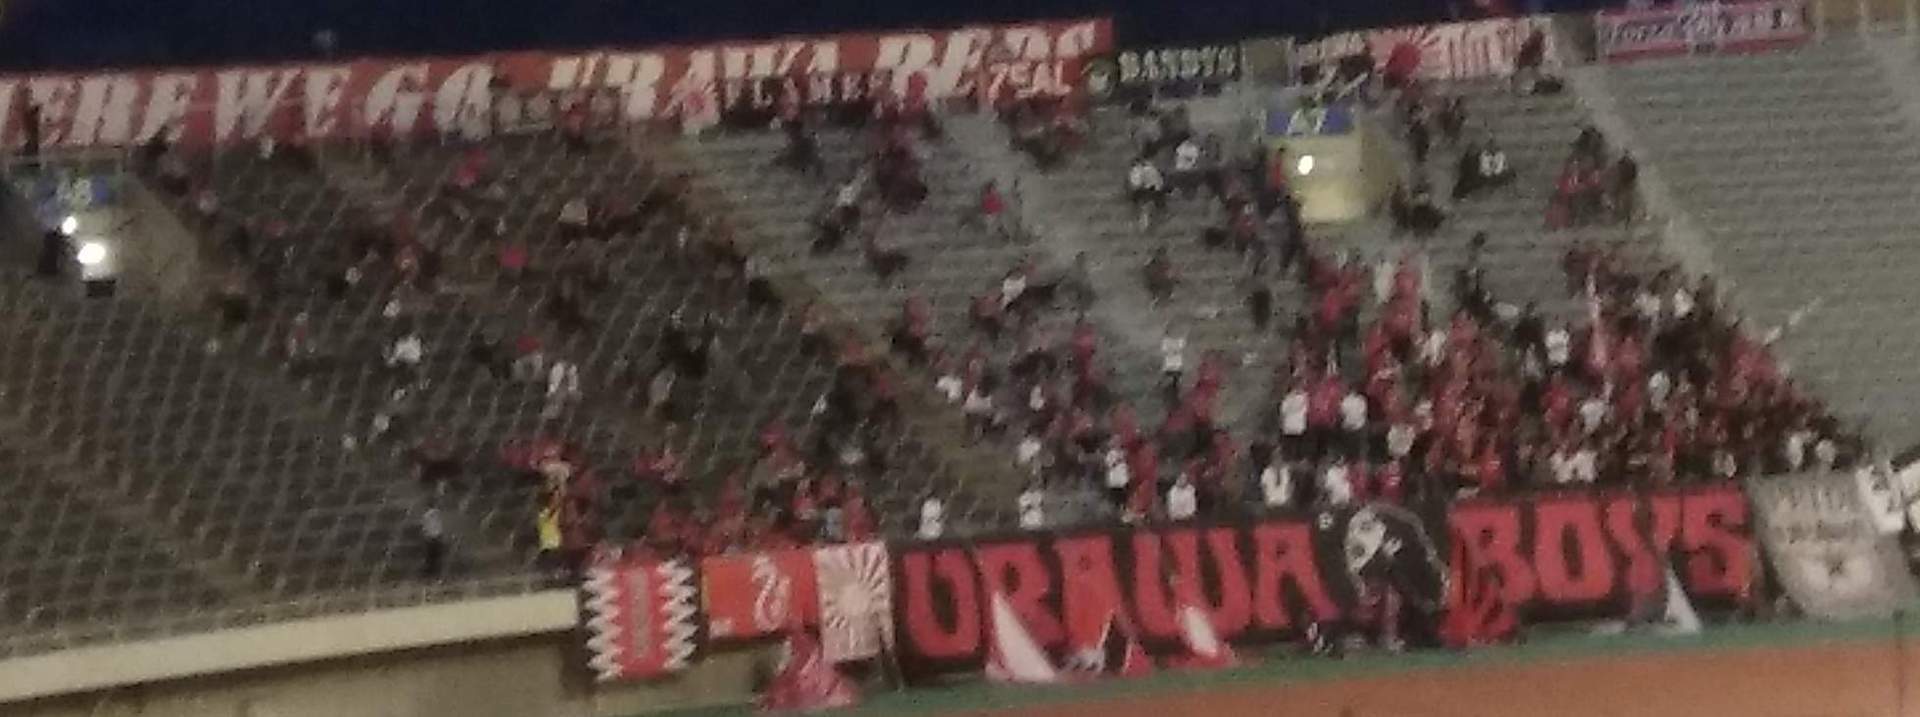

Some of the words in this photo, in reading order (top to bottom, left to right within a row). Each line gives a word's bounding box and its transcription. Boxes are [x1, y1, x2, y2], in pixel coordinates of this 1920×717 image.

[215, 66, 352, 141] WE
[904, 520, 1341, 659] URAWA
[1448, 485, 1753, 608] BOYS
